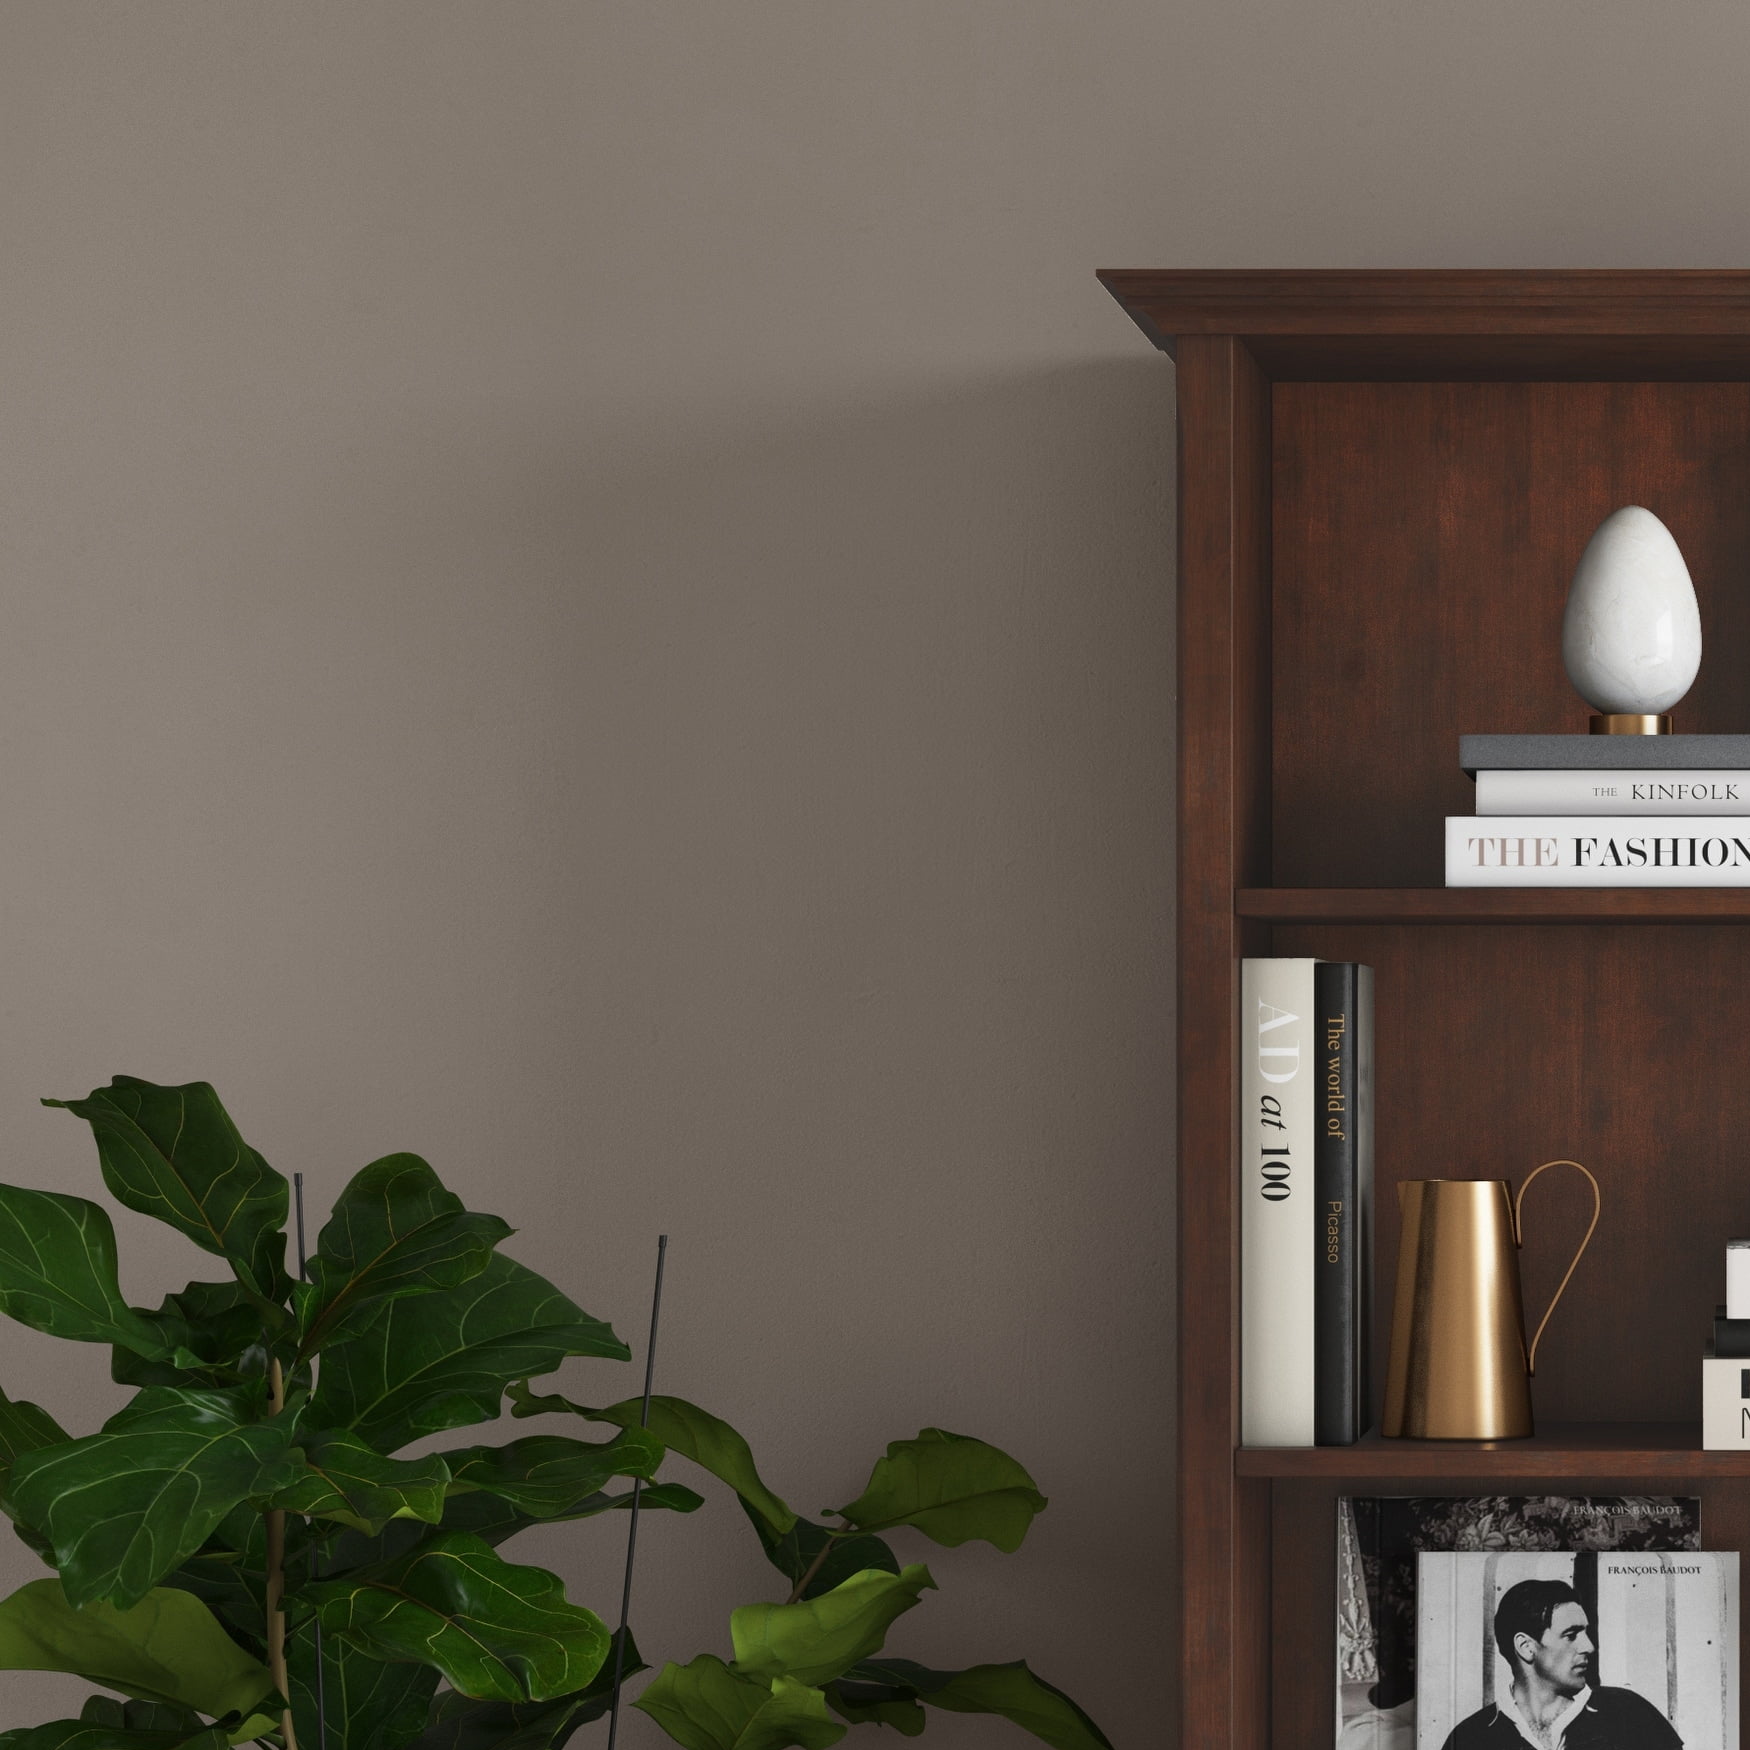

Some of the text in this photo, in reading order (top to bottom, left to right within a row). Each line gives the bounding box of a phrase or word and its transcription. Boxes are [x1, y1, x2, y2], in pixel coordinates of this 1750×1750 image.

[1592, 788, 1617, 796] THE
[1632, 784, 1739, 799] KINFOLK
[1468, 838, 1558, 866] THE
[1259, 996, 1300, 1201] AD at 100
[1328, 1014, 1345, 1263] The world of Picasso
[1574, 1506, 1681, 1517] FRANÇOIS BAUDOT
[1608, 1566, 1702, 1576] FRANÇOIS BAUDOT
